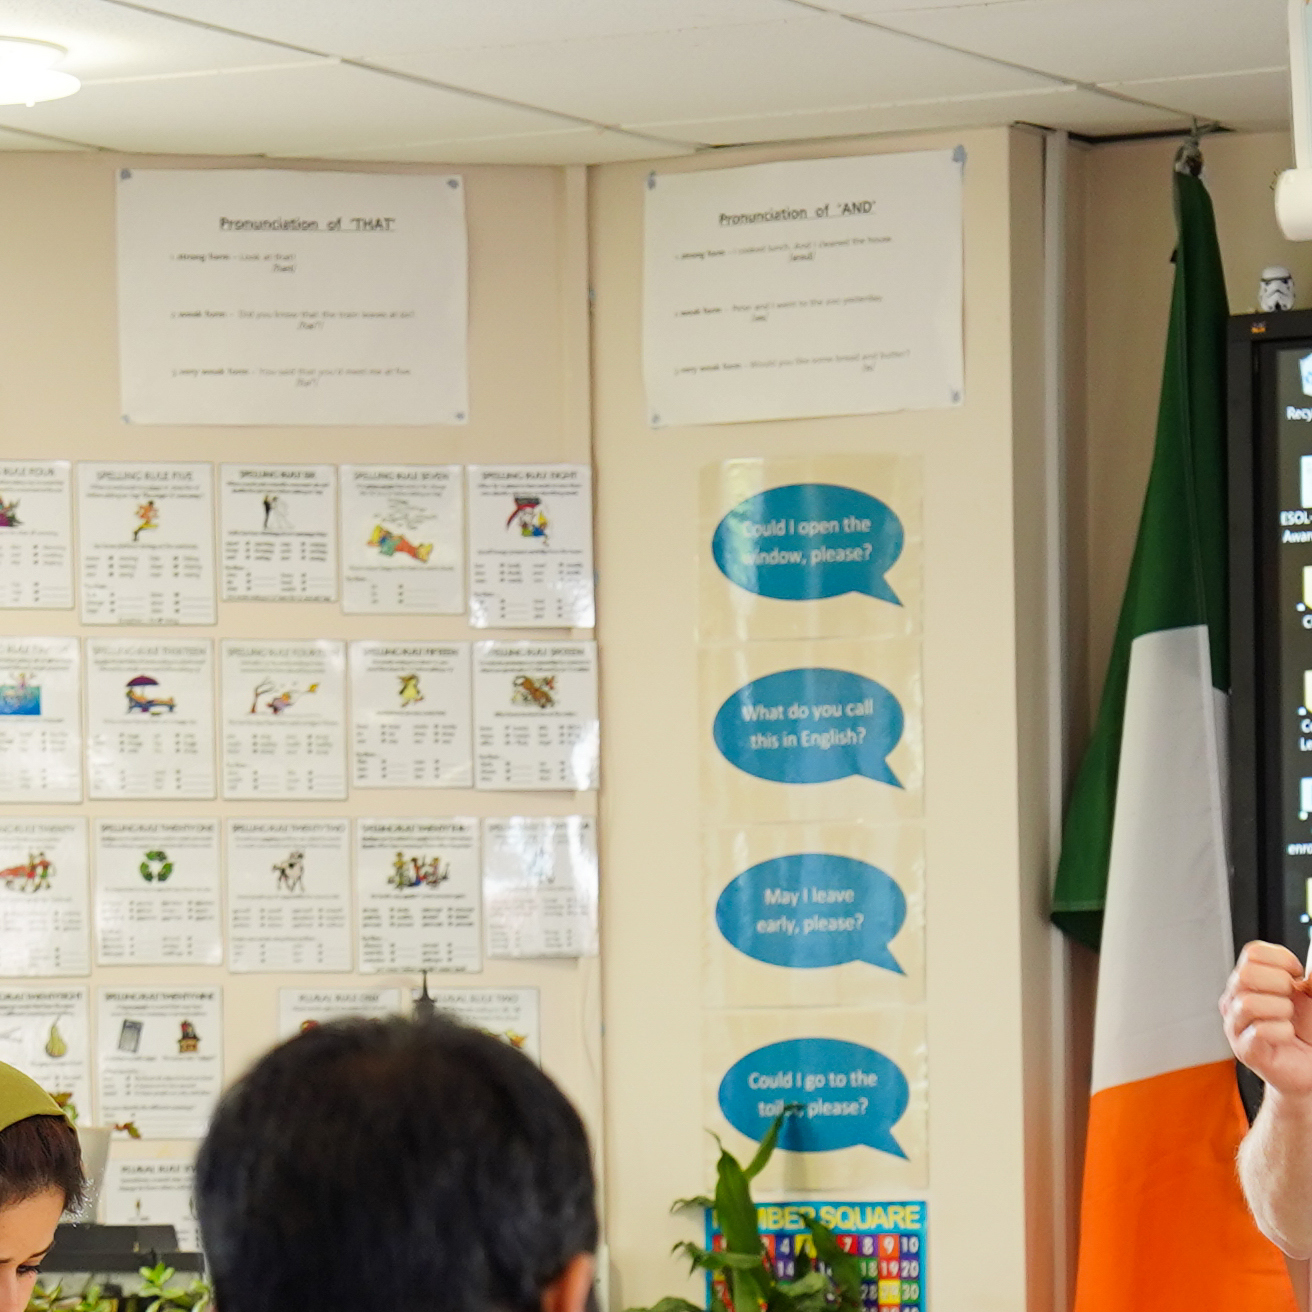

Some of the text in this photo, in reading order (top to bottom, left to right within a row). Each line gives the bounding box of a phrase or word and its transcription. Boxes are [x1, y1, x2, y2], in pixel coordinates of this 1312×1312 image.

[220, 217, 319, 231] Pronunciation
[327, 217, 342, 231] of
[718, 207, 807, 227] Pronunciation
[816, 204, 830, 218] of
[742, 519, 786, 538] Could
[798, 519, 839, 540] open
[843, 515, 872, 533] the
[810, 543, 873, 566] please?
[742, 698, 874, 724] What do you call
[749, 726, 867, 750] this in English?
[764, 887, 799, 907] May
[811, 885, 855, 903] leave
[803, 912, 865, 936] please?
[748, 1069, 878, 1093] Could I go to the
[806, 1096, 869, 1119] please?
[819, 1206, 921, 1229] SQUARE
[900, 1236, 919, 1254] 10
[901, 1259, 919, 1277] 20
[901, 1283, 919, 1299] 30
